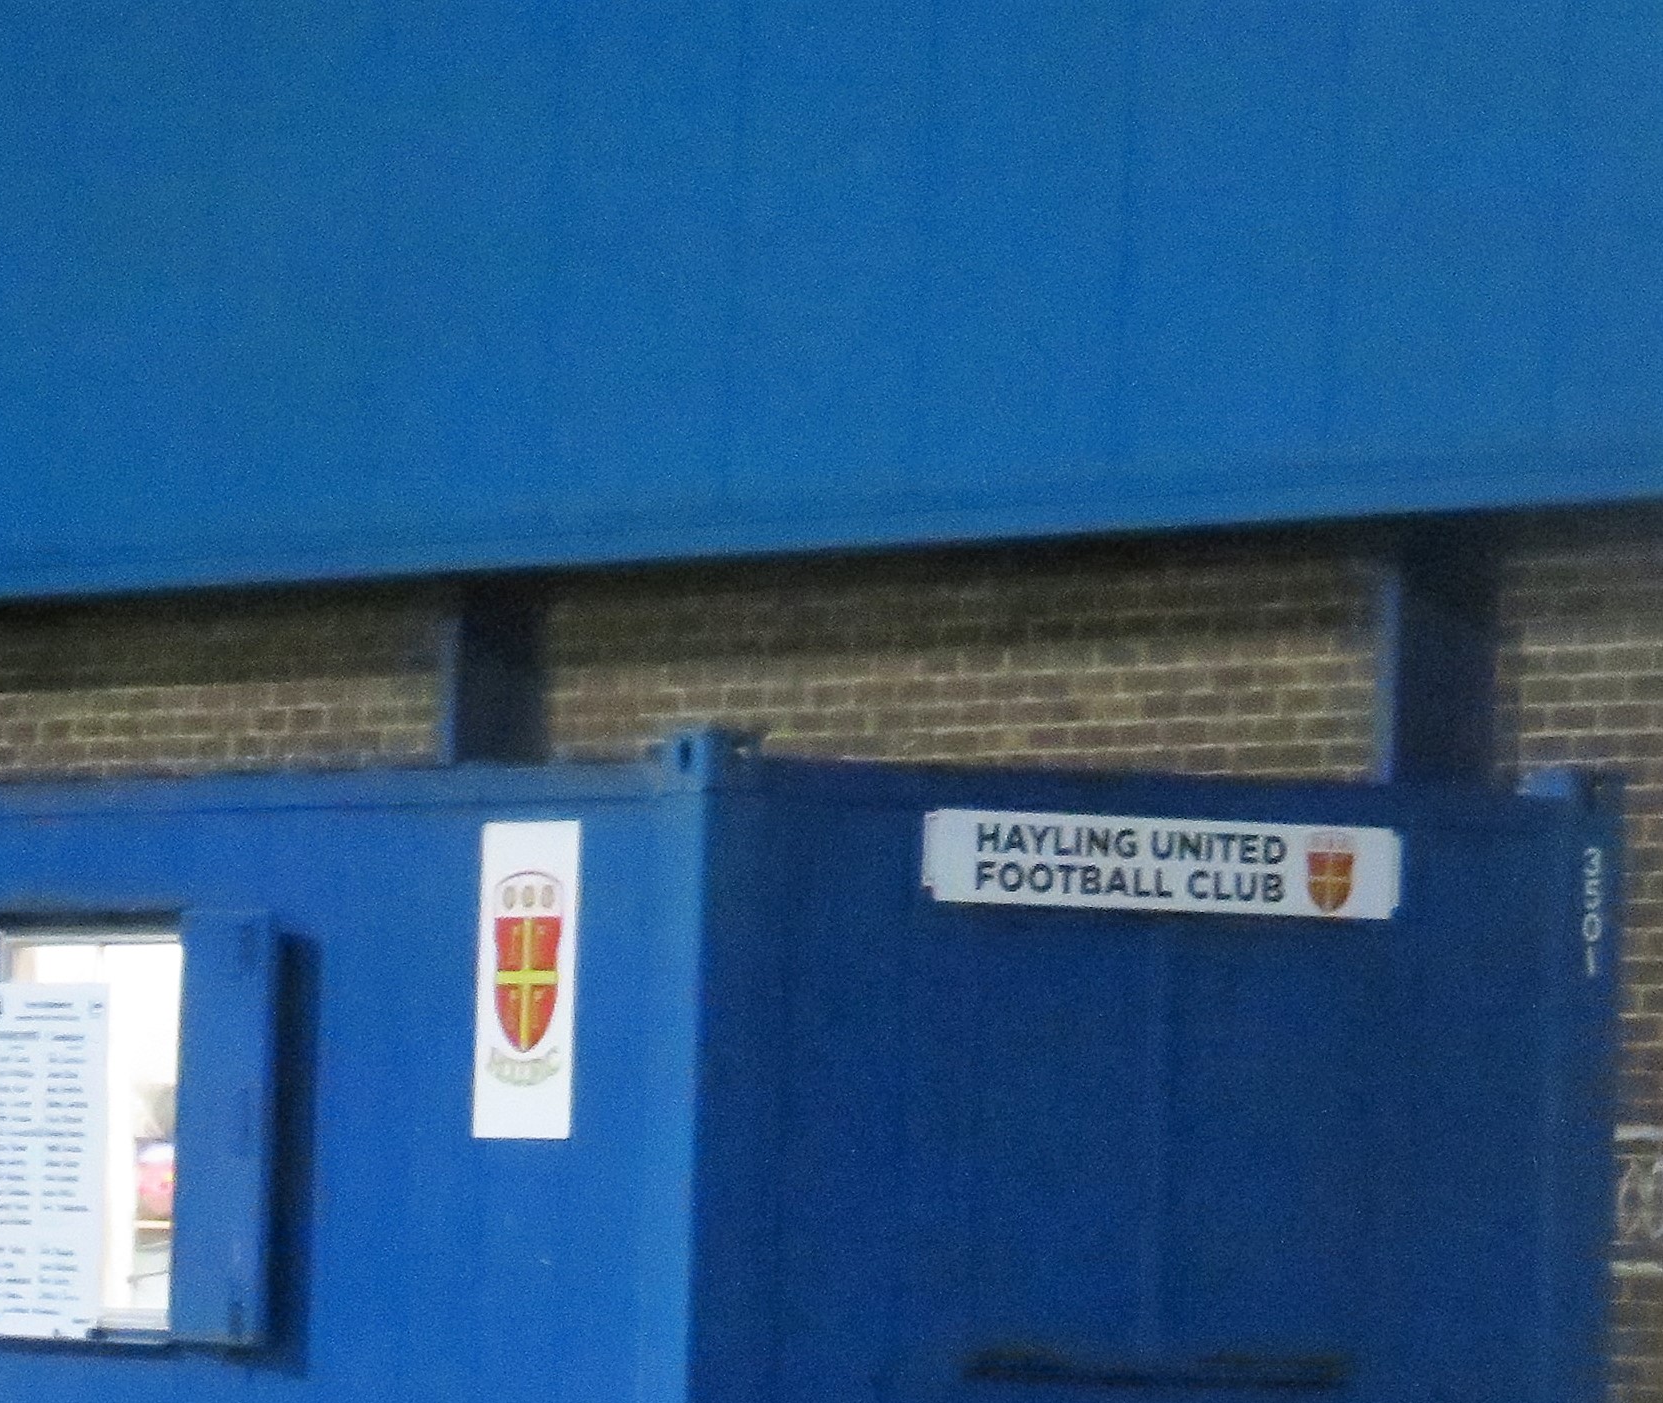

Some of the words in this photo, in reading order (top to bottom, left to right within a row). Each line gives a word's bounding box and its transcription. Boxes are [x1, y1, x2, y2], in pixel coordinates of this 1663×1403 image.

[976, 823, 1138, 860] HAYLING
[1150, 831, 1288, 866] UNITED
[975, 861, 1174, 899] FOOTBALL
[1186, 870, 1285, 904] CLUB
